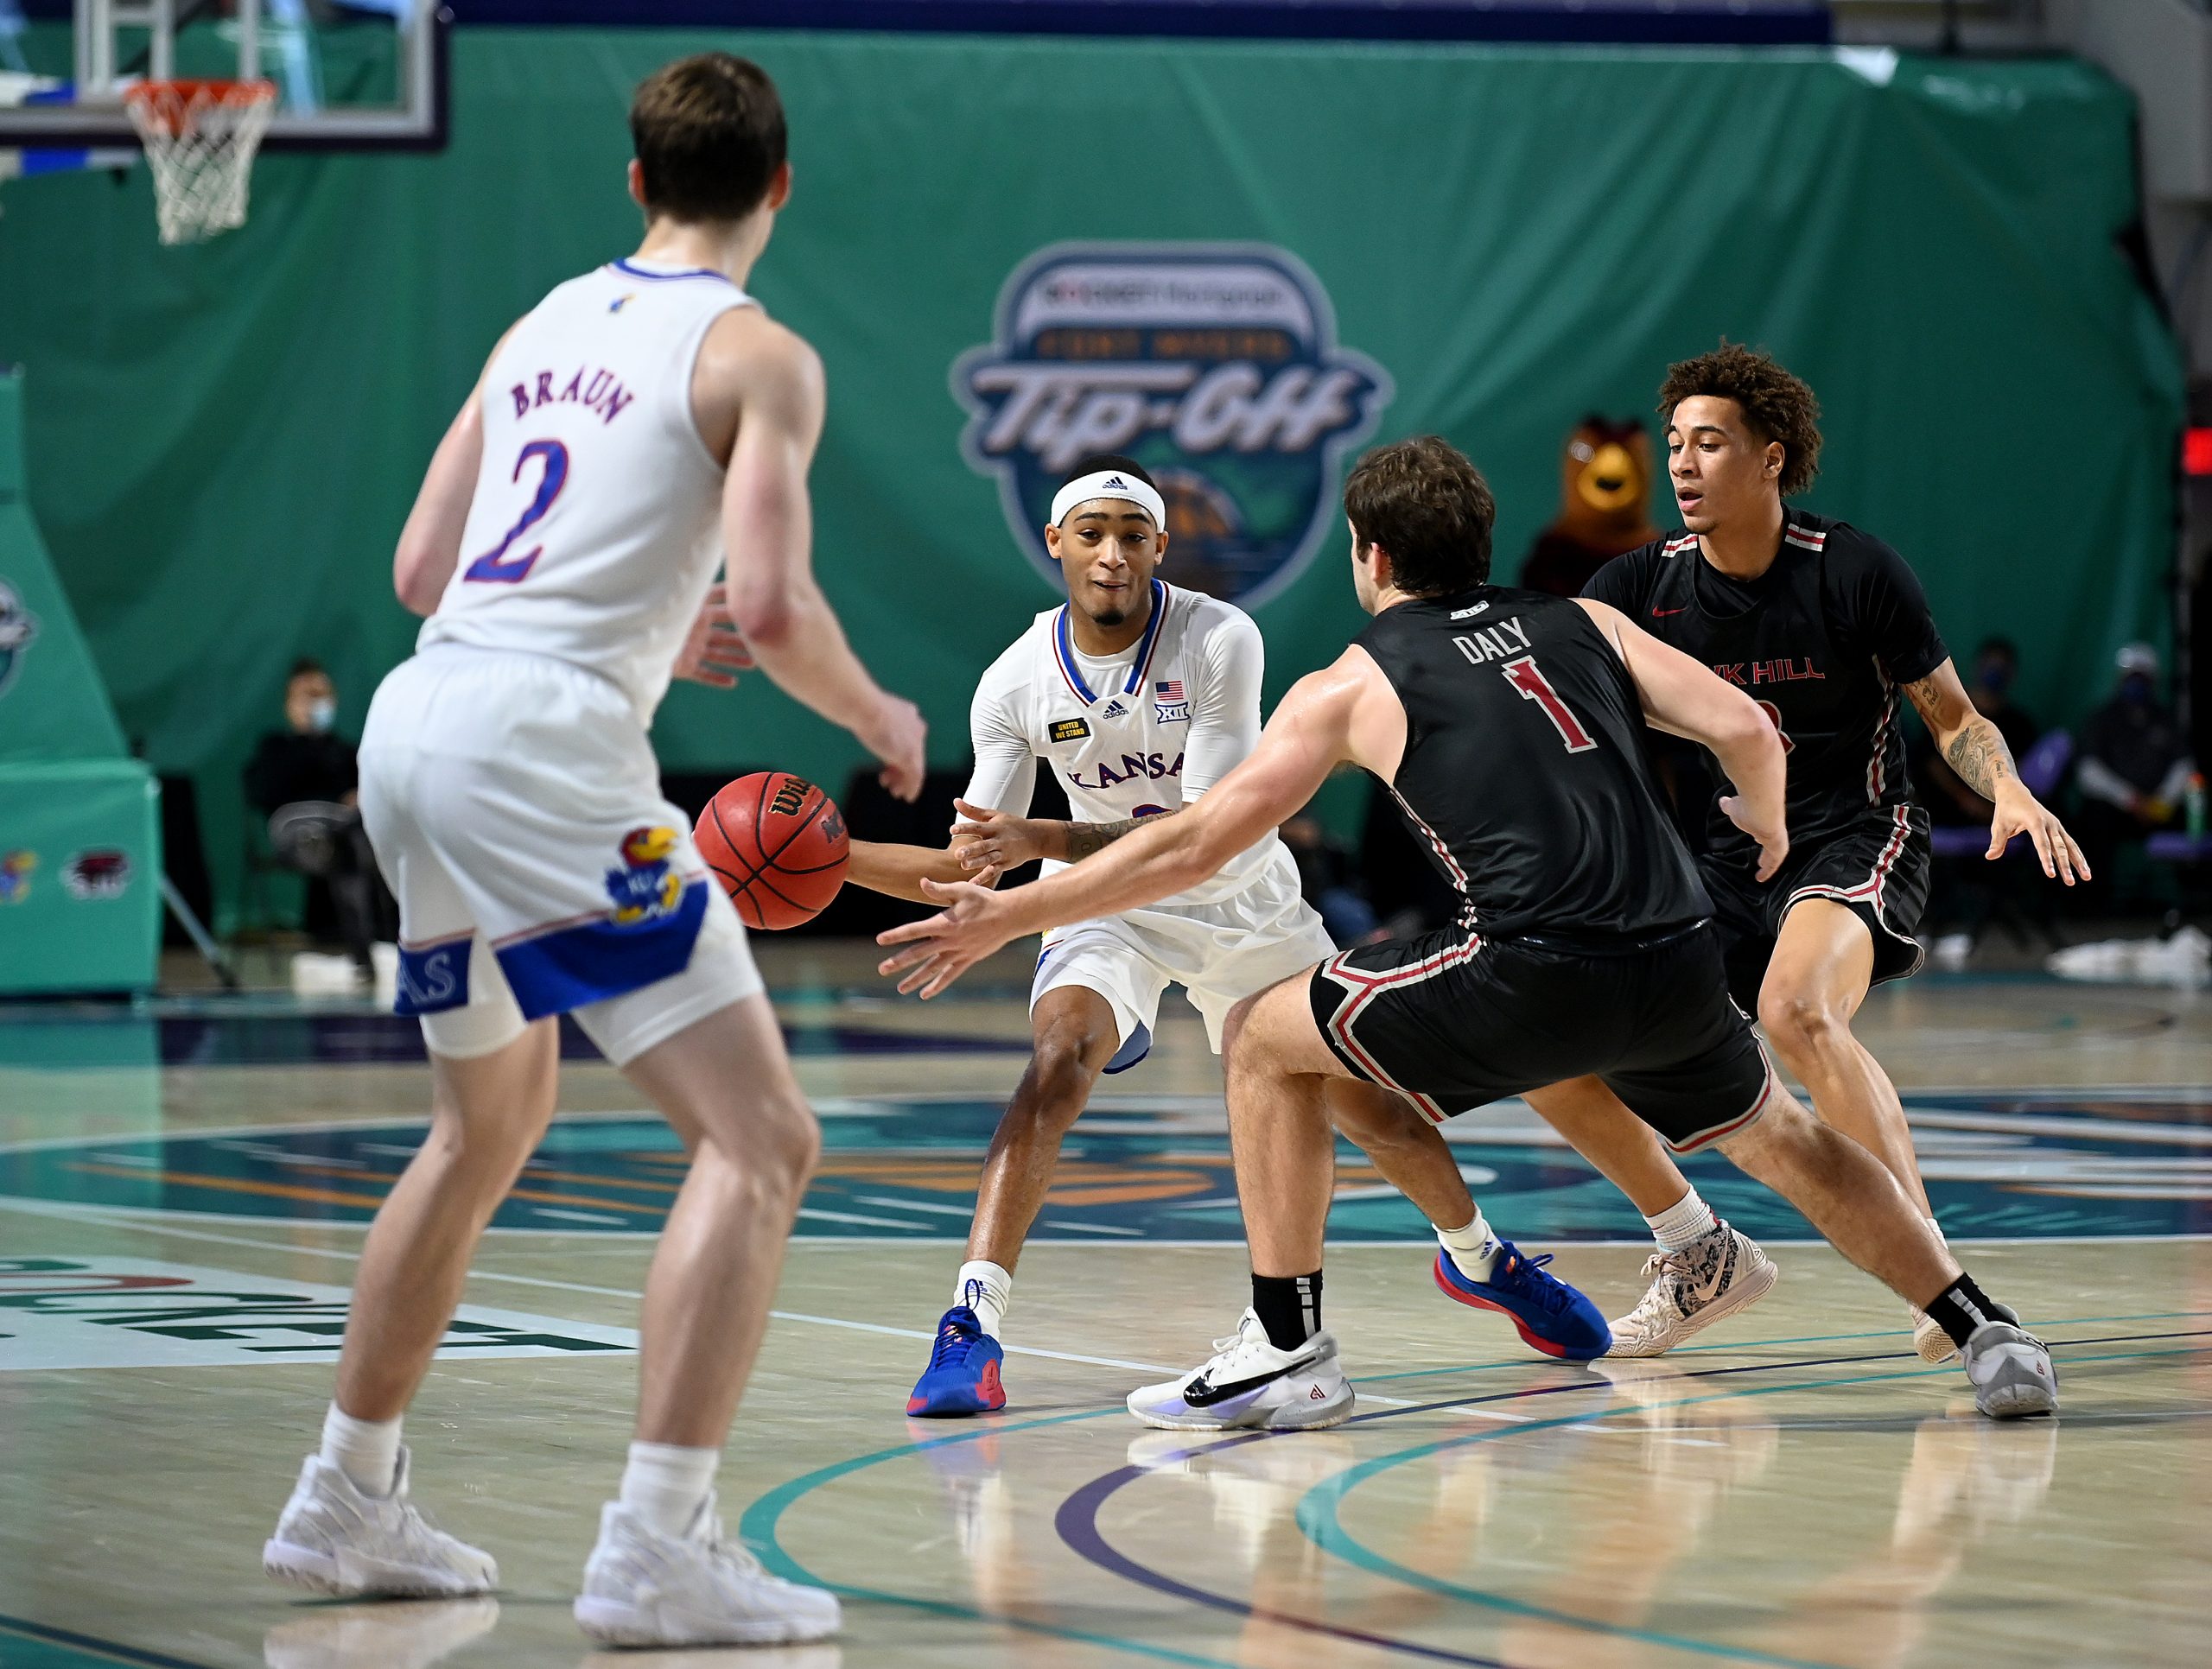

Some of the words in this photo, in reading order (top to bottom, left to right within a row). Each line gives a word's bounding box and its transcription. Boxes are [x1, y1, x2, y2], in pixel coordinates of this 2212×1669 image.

[510, 365, 635, 425] BRAUN
[463, 437, 570, 583] 2
[1452, 616, 1532, 664] DALY
[1752, 657, 1826, 684] HILL
[1103, 708, 1129, 720] adidas
[1502, 655, 1599, 753] 1
[1058, 721, 1079, 731] UNITED
[1065, 727, 1085, 738] STAND
